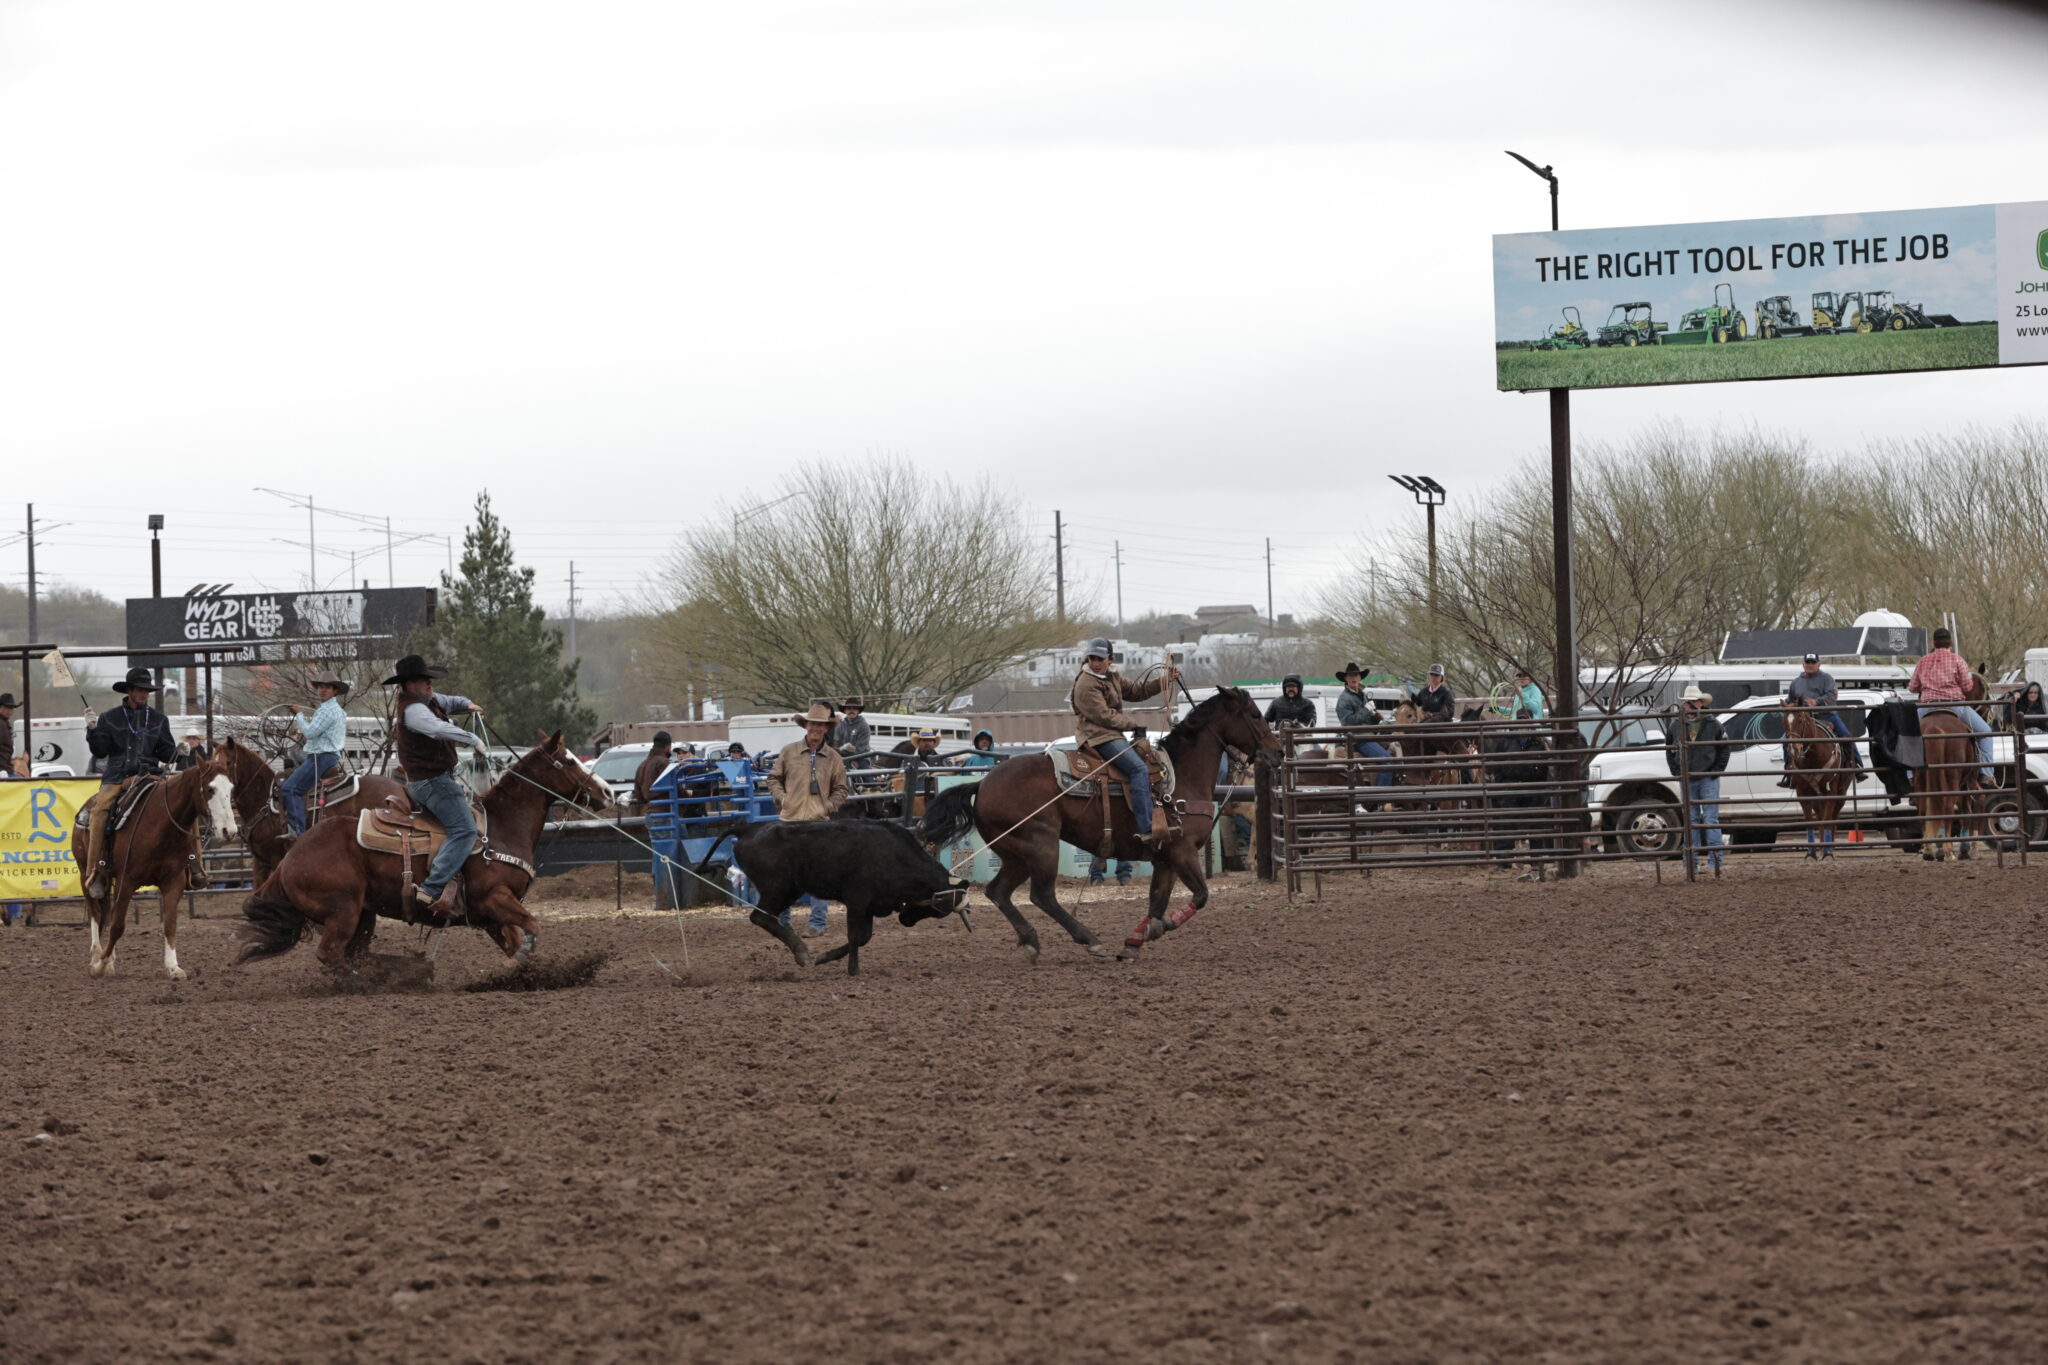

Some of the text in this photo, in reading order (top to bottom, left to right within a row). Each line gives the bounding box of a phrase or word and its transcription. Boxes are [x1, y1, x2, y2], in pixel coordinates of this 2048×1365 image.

[1535, 233, 1949, 282] THE RIGHT TOOL FOR THE JOB
[2015, 281, 2048, 294] JOH
[2015, 305, 2030, 317] 25
[184, 597, 240, 622] WYLD
[184, 621, 239, 640] GEAR
[31, 788, 62, 828] R
[1, 832, 21, 840] ESTD
[0, 849, 76, 864] NCHO
